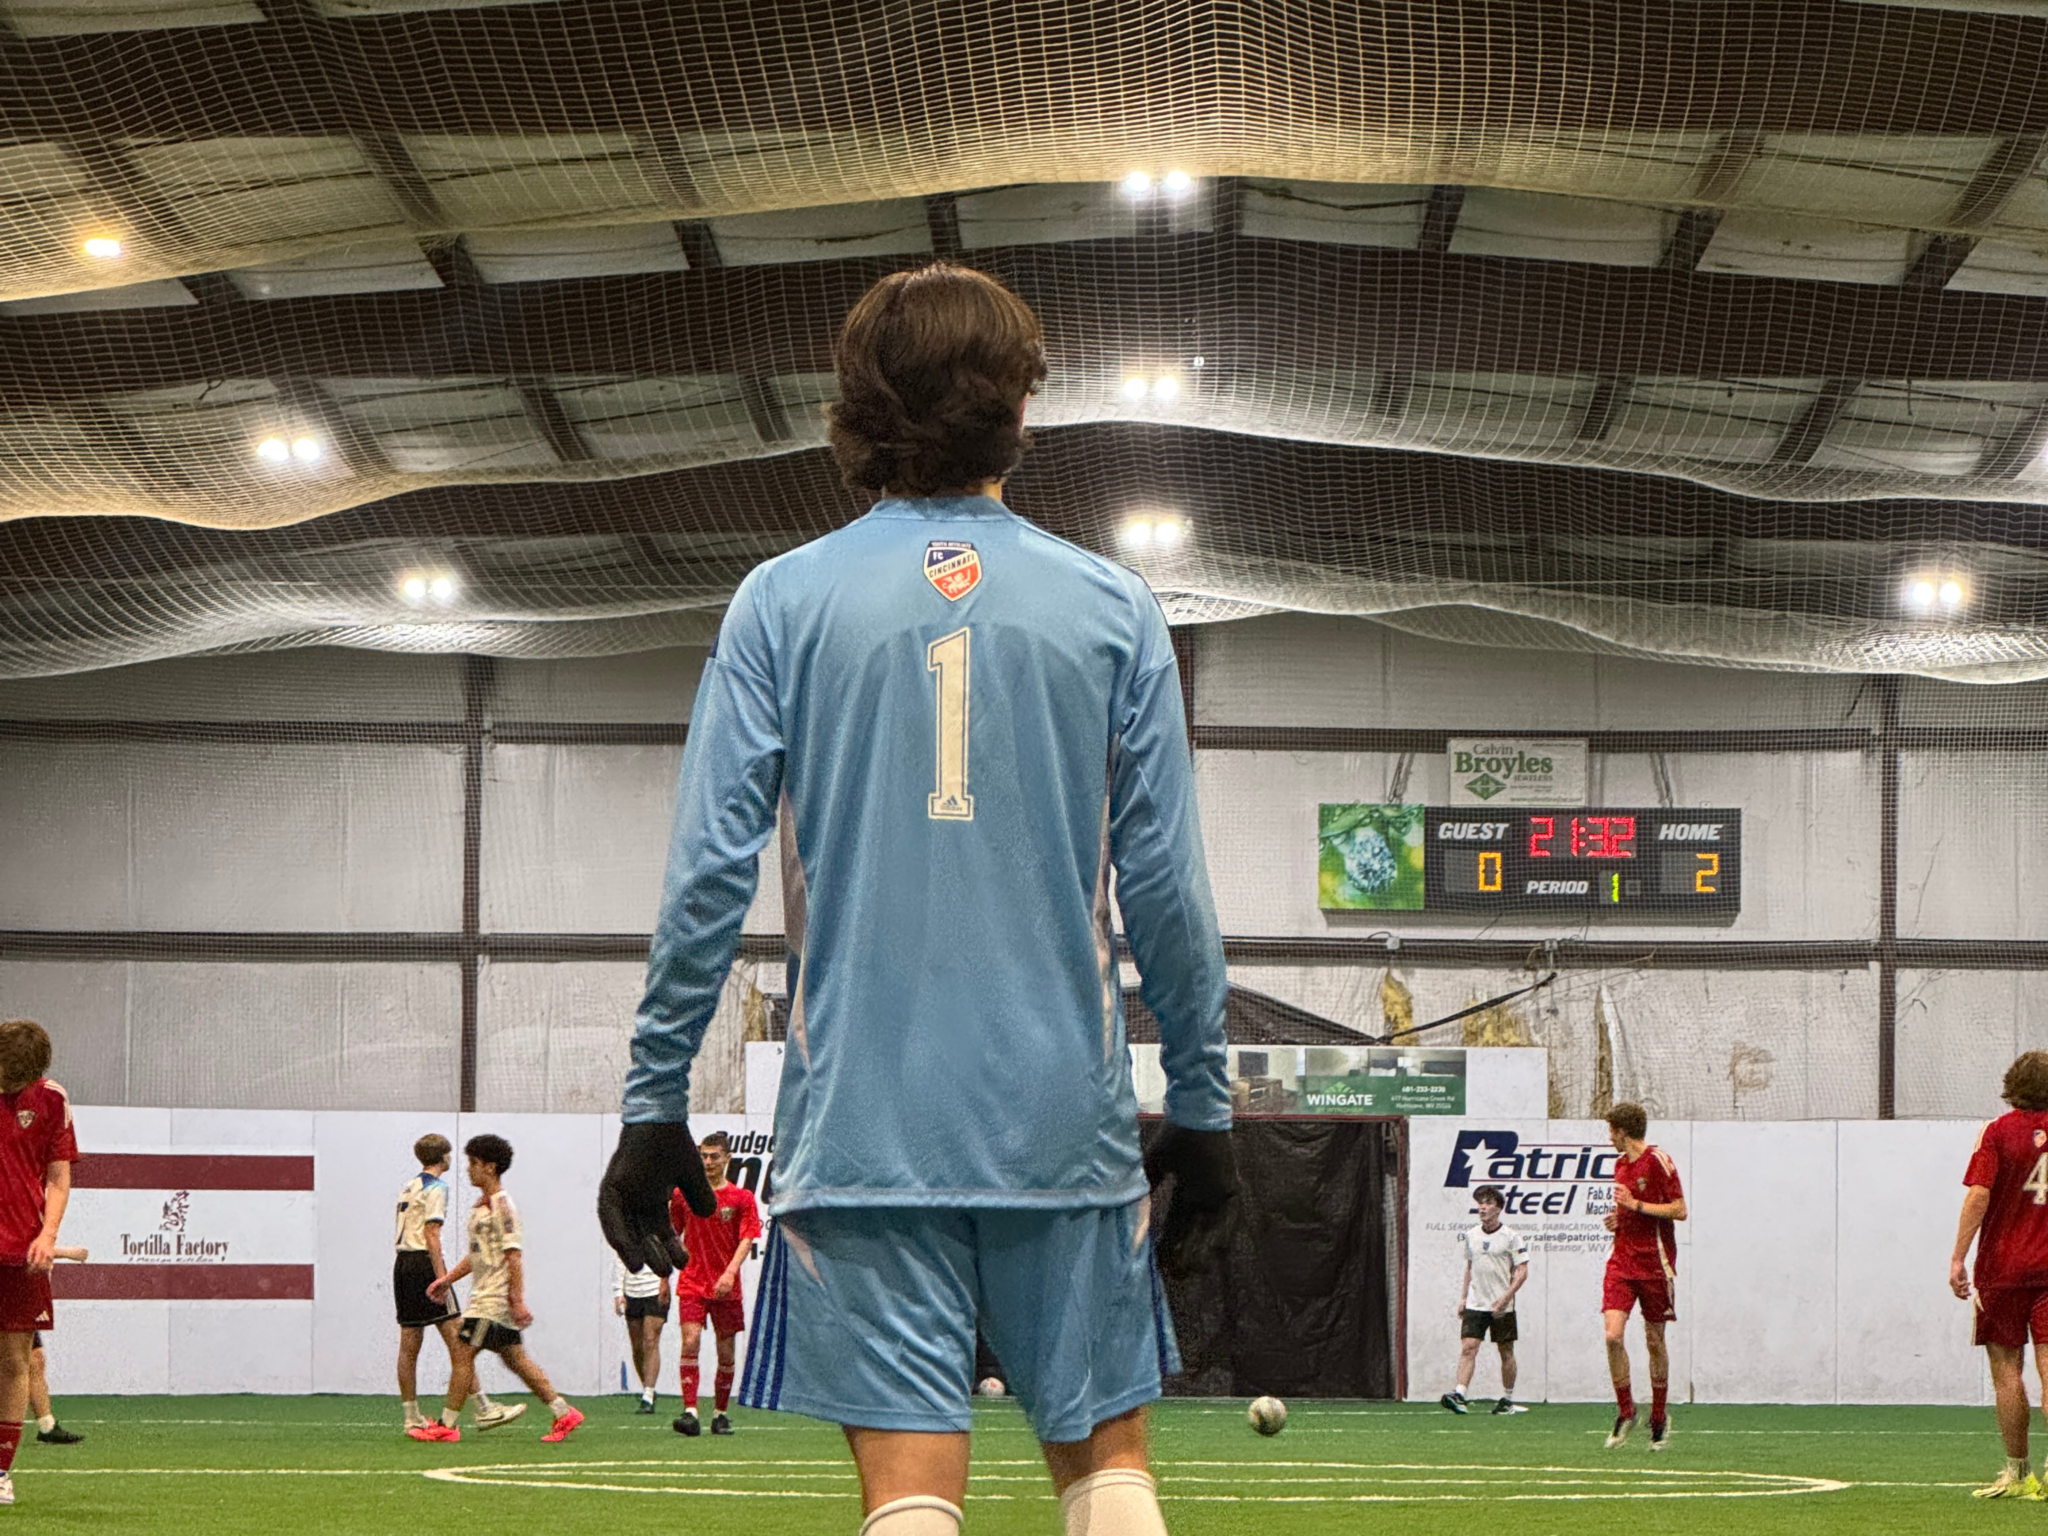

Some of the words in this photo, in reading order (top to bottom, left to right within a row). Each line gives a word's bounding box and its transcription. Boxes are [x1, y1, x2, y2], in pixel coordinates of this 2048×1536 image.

[929, 553, 975, 578] CINCINNATI
[932, 551, 944, 561] FC
[928, 627, 973, 820] 1
[1473, 743, 1513, 755] Calvin
[1454, 750, 1554, 779] Broyles
[1438, 823, 1509, 840] GUEST
[1530, 816, 1636, 857] 21:32
[1659, 823, 1723, 840] HOME
[1478, 852, 1502, 891] 0
[1695, 853, 1719, 892] 2
[1526, 880, 1589, 895] PERIOD
[1611, 873, 1619, 902] 1
[1306, 1093, 1374, 1106] WINGATE
[120, 1233, 171, 1256] Tortilla
[175, 1233, 230, 1262] Factory
